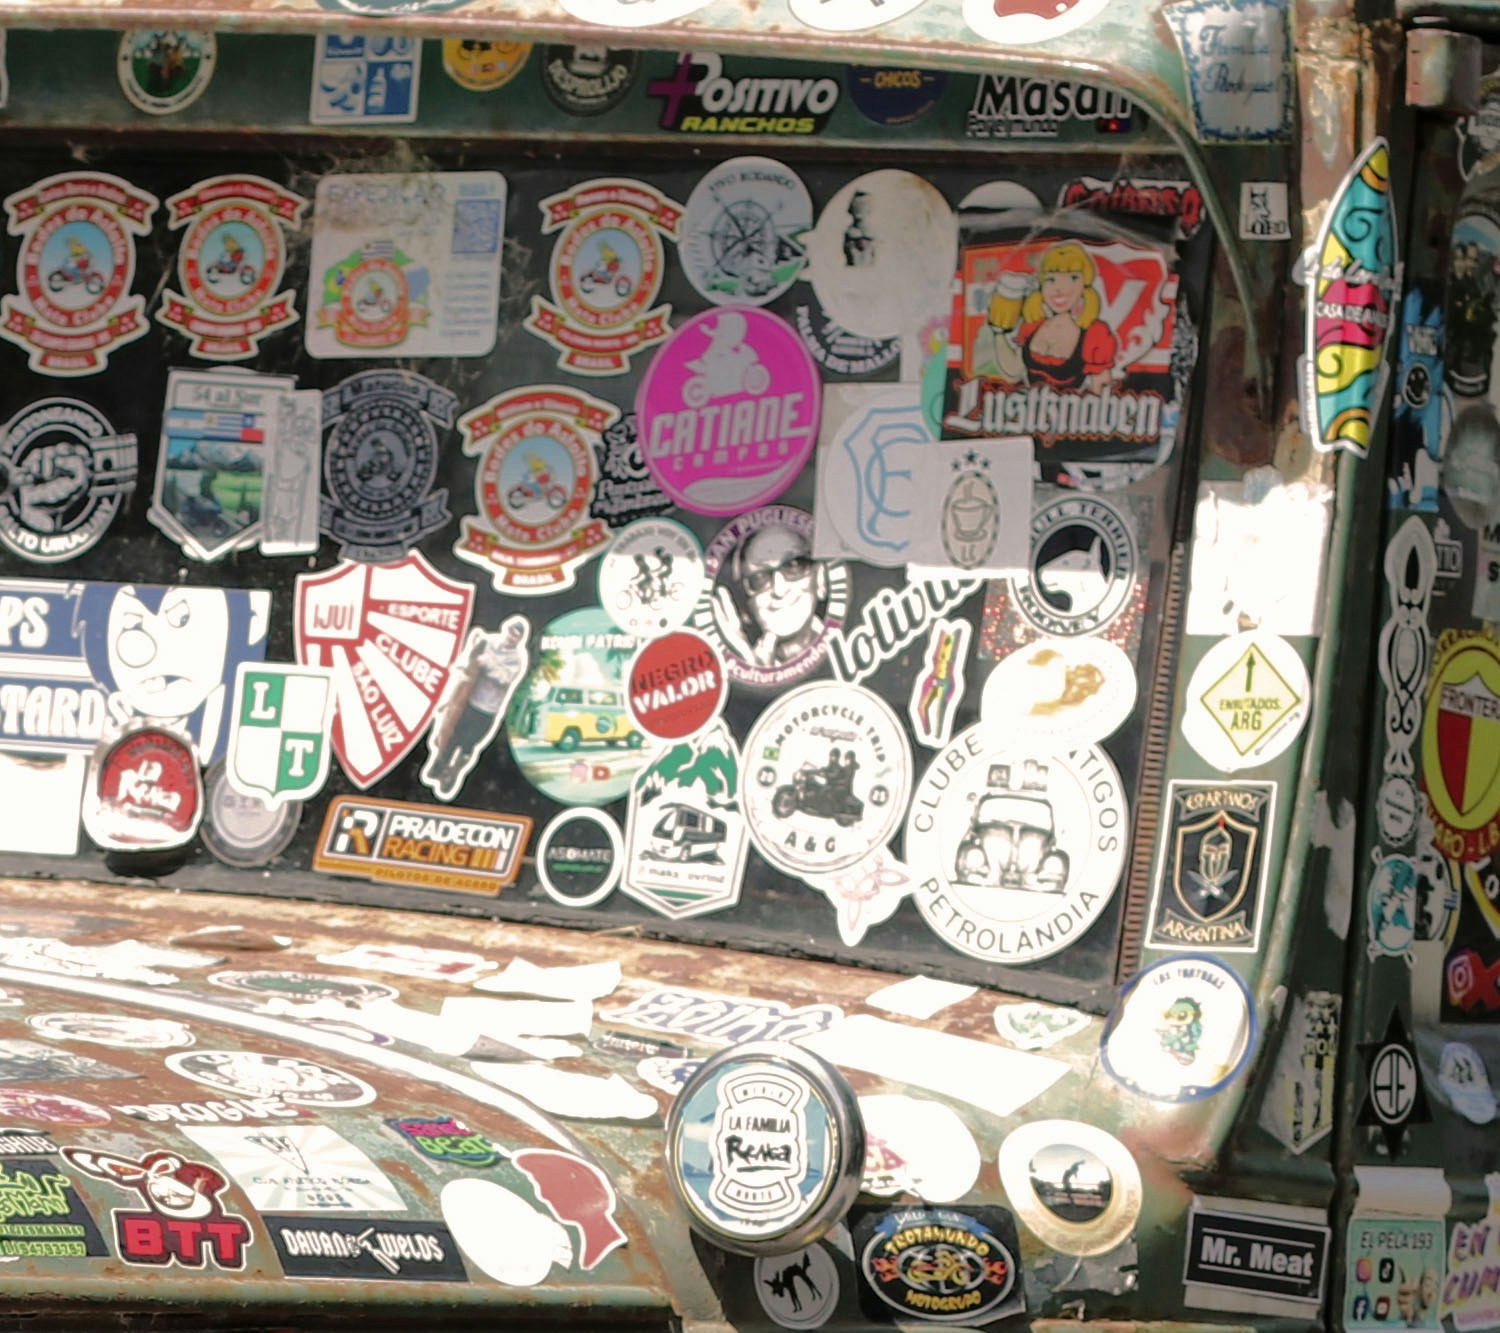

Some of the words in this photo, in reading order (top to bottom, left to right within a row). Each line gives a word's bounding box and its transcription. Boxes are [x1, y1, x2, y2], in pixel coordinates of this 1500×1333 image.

[681, 118, 814, 133] RANCHOS
[652, 391, 810, 445] CATIANE
[387, 602, 459, 629] ESPORTE
[375, 633, 444, 692] CLUBE
[630, 653, 715, 696] NEGRO
[633, 674, 717, 713] VALOR
[776, 704, 865, 746] MOTORCYCLE
[866, 724, 886, 763] TRIP
[1230, 709, 1262, 732] ARG
[914, 732, 983, 833] CLUBE
[388, 815, 514, 850] PRADECON
[382, 839, 468, 864] RACING
[1161, 918, 1246, 941] ARGENTINA
[124, 1218, 249, 1262] BTT
[886, 1226, 989, 1257] TROTAMUNDO
[1202, 1234, 1240, 1267] Mr.
[1250, 1243, 1314, 1277] Meat
[905, 1289, 982, 1310] MOTOGRUPO
